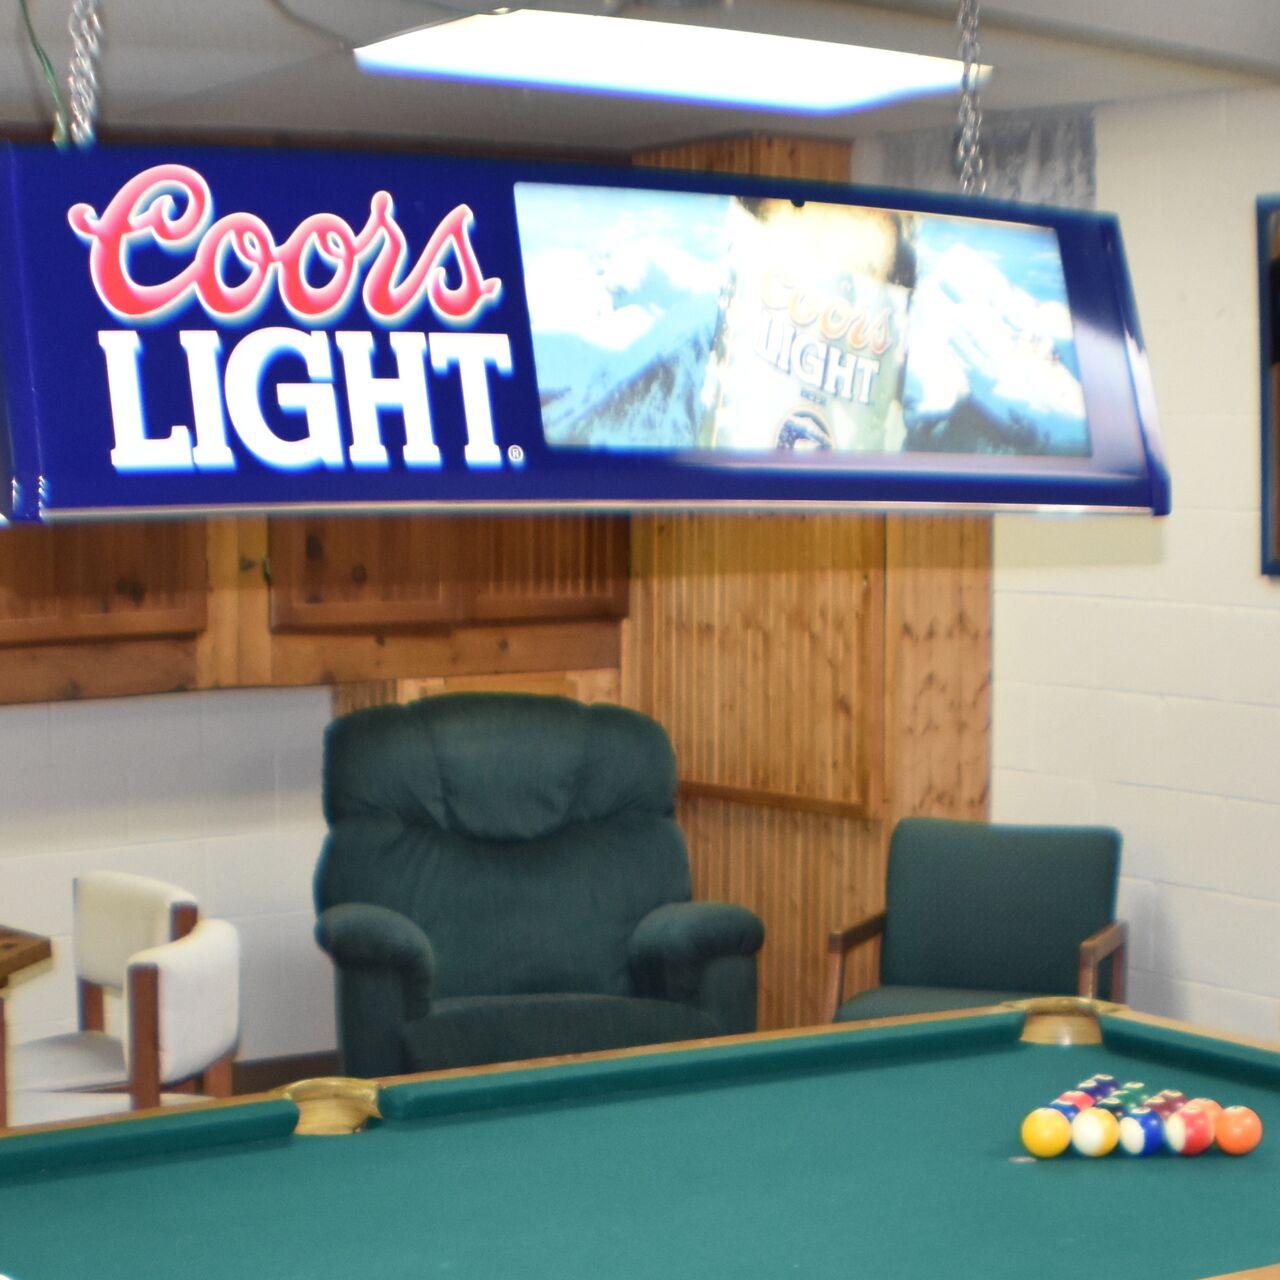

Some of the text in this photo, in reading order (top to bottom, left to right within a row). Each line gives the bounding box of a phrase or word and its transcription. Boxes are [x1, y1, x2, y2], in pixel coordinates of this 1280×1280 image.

[67, 162, 503, 321] Coors
[98, 326, 513, 471] LIGHT
[755, 312, 882, 406] LIGHT
